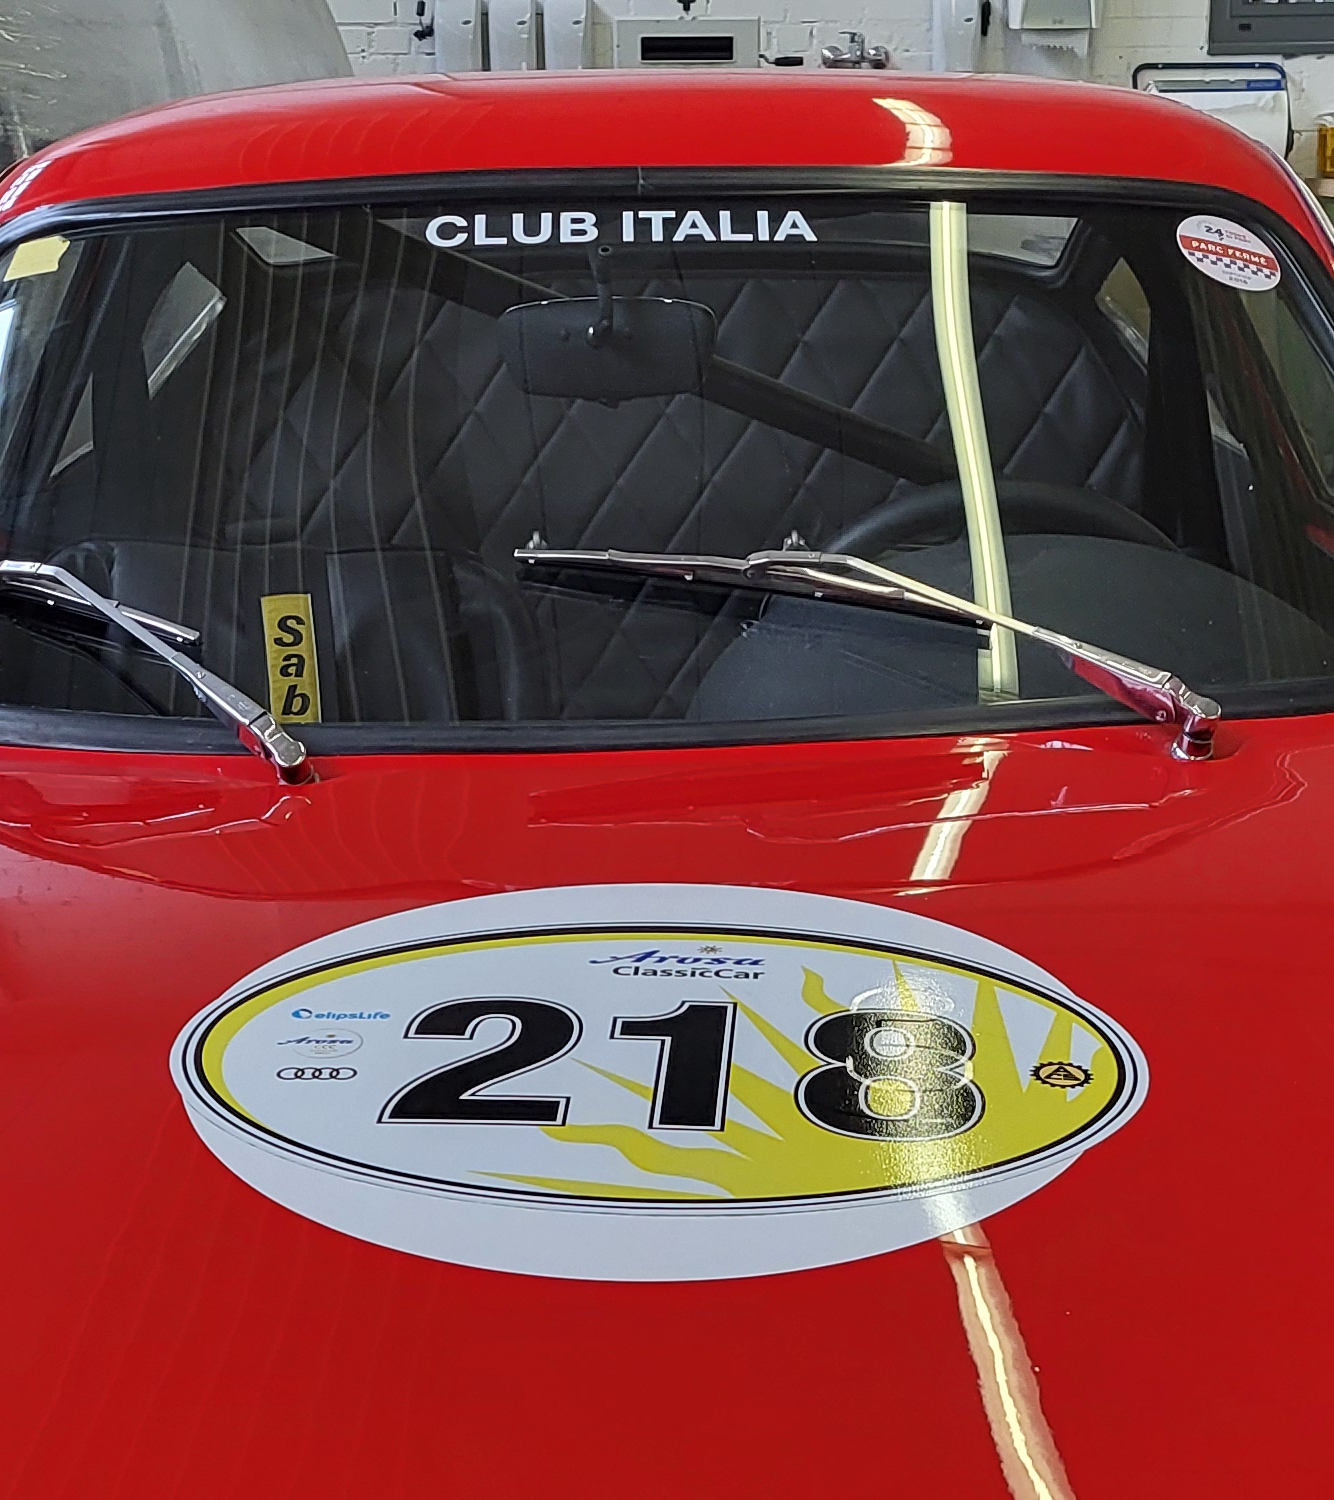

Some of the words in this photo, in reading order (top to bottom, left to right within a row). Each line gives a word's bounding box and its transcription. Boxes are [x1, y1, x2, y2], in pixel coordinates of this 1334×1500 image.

[424, 210, 599, 248] CLUB
[621, 210, 819, 244] ITALIA
[1190, 240, 1225, 254] PARC
[273, 615, 311, 716] Sab
[589, 949, 766, 966] Arosa
[612, 965, 766, 980] ClassicCar
[376, 995, 986, 1142] 218
